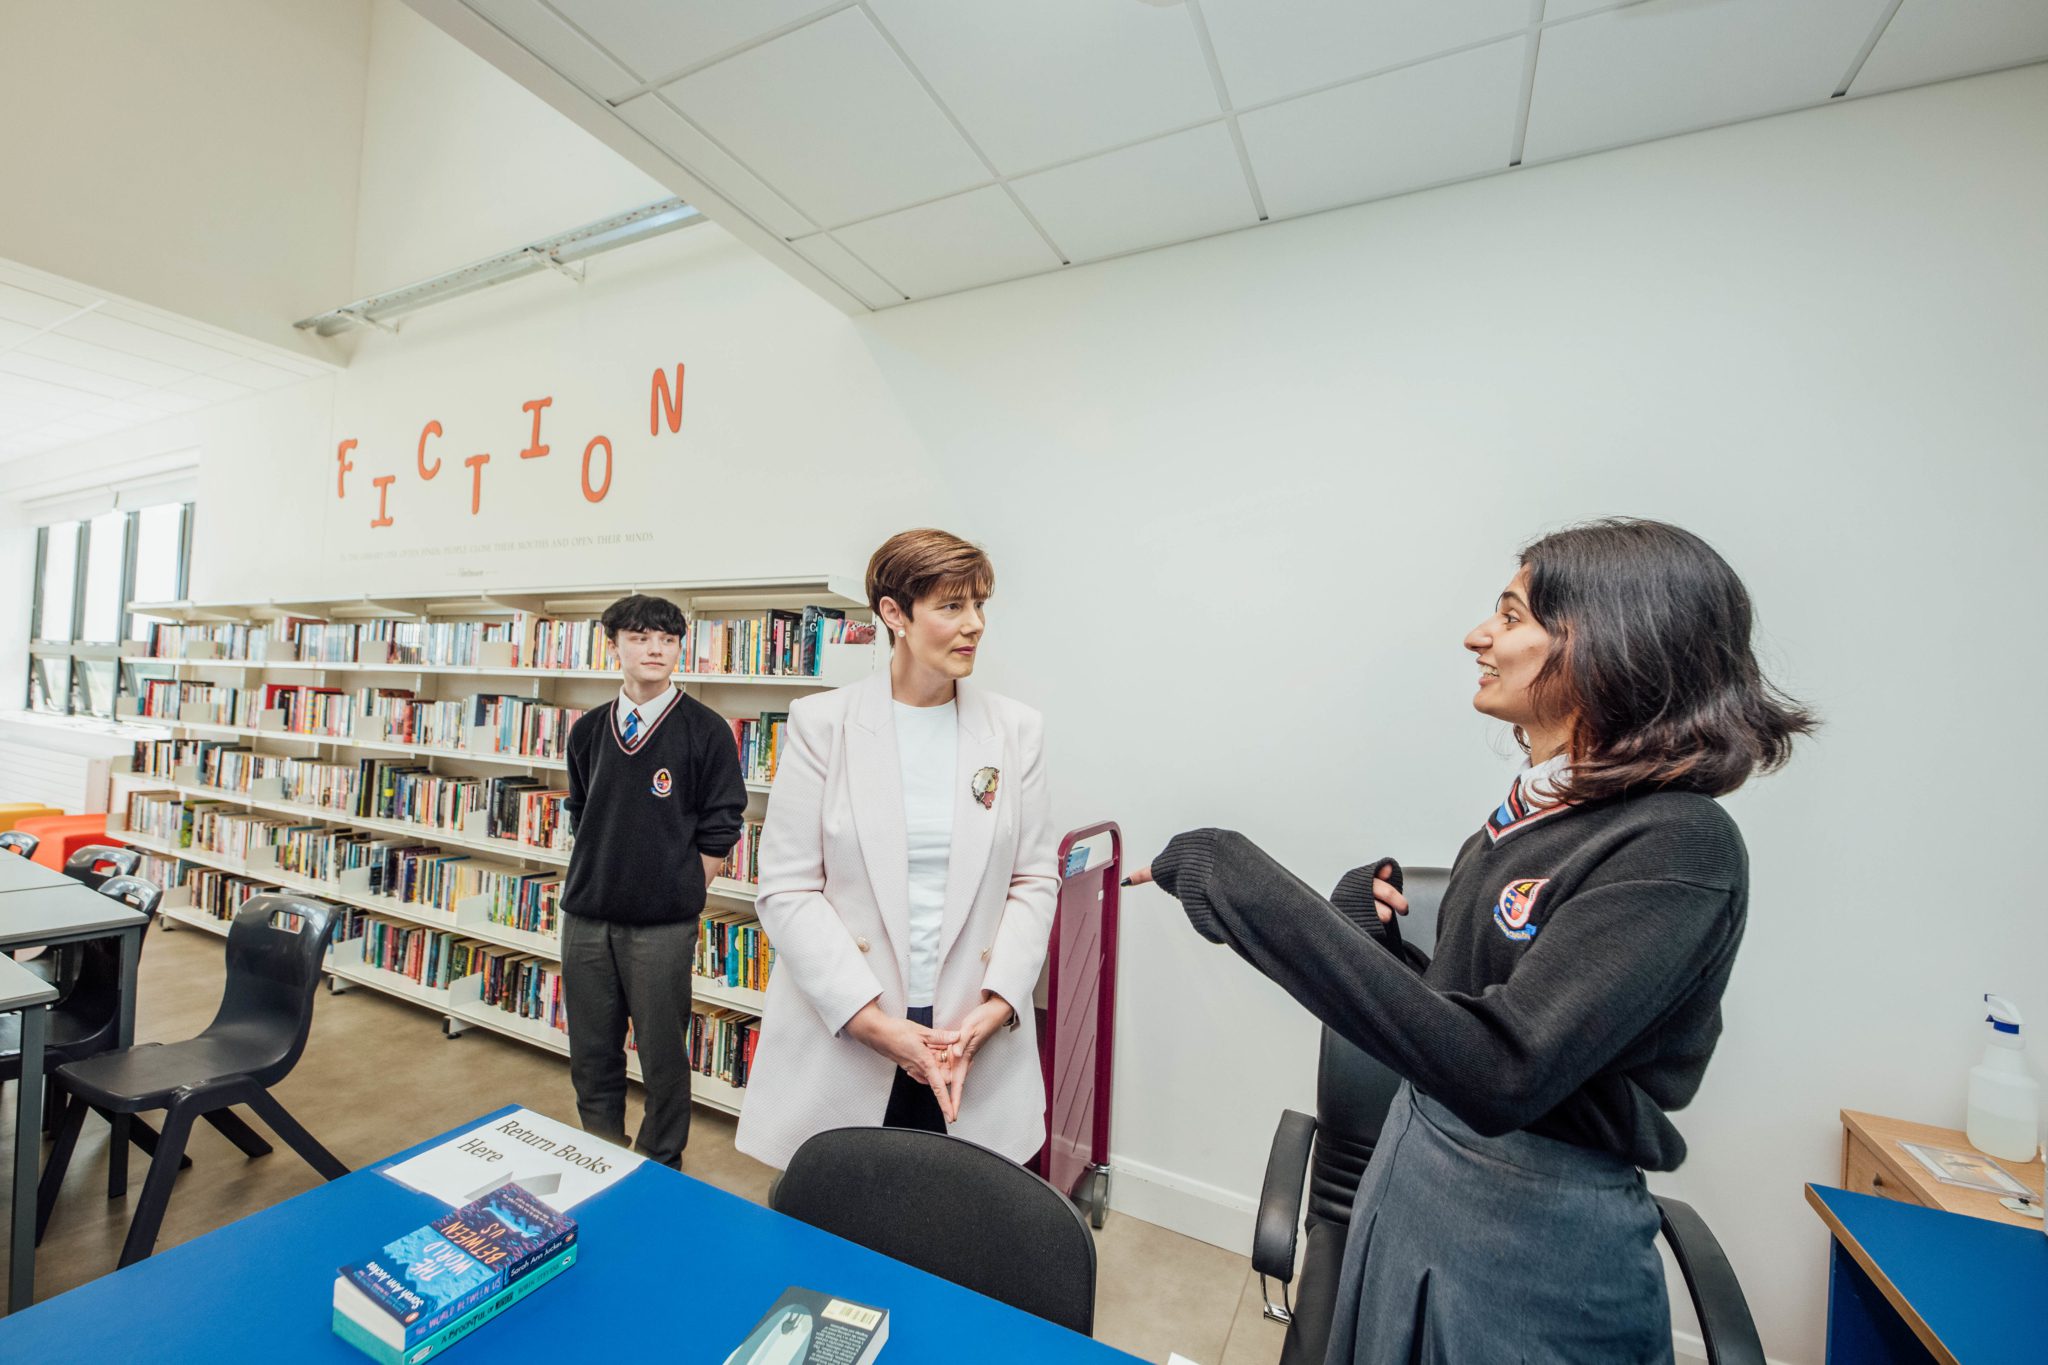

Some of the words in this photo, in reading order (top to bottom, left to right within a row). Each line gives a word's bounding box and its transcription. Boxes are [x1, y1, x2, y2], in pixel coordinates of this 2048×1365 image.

[337, 362, 685, 528] FICTION
[552, 538, 569, 548] AND
[572, 536, 593, 546] OPEN
[597, 534, 622, 545] THEIR
[457, 1138, 504, 1163] Here
[496, 1120, 556, 1152] Return
[553, 1144, 612, 1175] Books
[440, 1220, 508, 1264] BETWEEN
[480, 1222, 506, 1239] US
[409, 1257, 446, 1281] THE
[423, 1240, 475, 1276] WORLD
[386, 1277, 405, 1293] Ann
[429, 1305, 455, 1328] WORLD
[457, 1287, 490, 1311] BETWEEN
[491, 1276, 501, 1291] US
[510, 1260, 529, 1277] Sarah
[530, 1253, 544, 1264] Ann
[397, 1288, 424, 1310] Sarah
